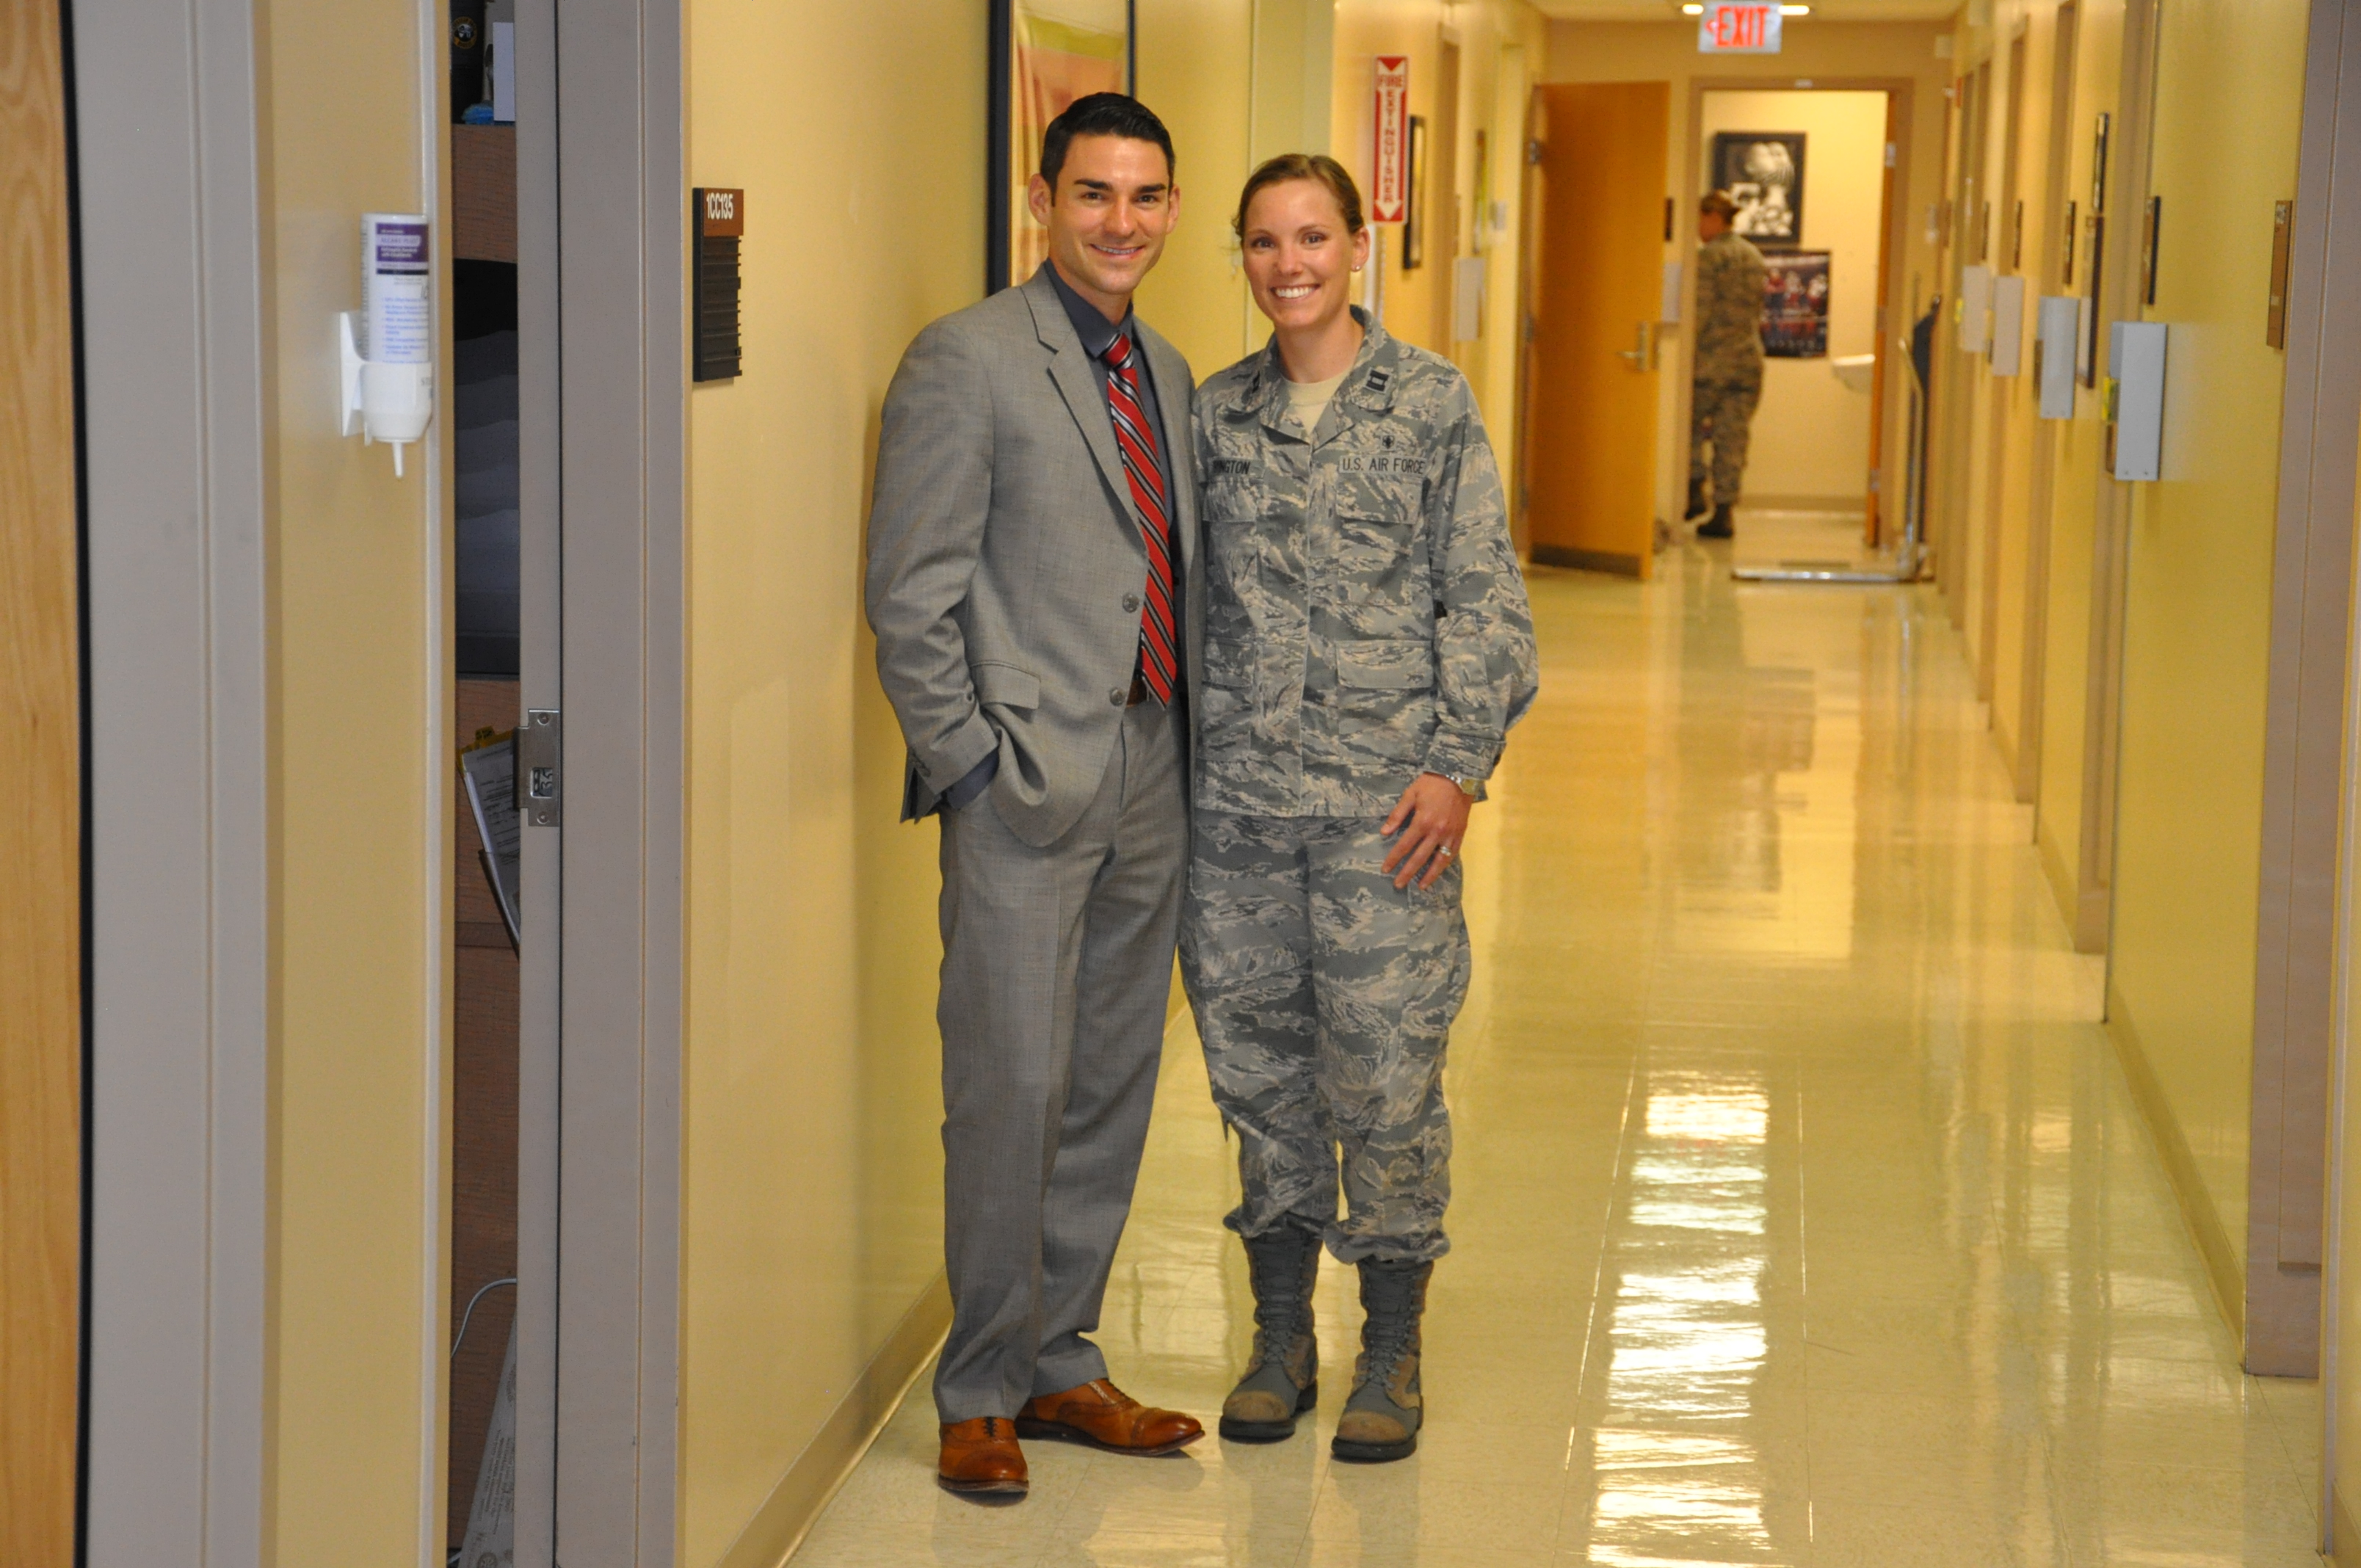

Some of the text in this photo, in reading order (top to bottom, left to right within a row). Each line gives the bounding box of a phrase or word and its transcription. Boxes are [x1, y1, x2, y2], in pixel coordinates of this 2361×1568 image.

[1716, 6, 1769, 47] EXIT
[1376, 76, 1403, 87] FIRE
[1383, 90, 1395, 203] EXTINGUISHER
[706, 192, 733, 219] 1CC135
[1343, 457, 1425, 474] U.S. AIR FORCE
